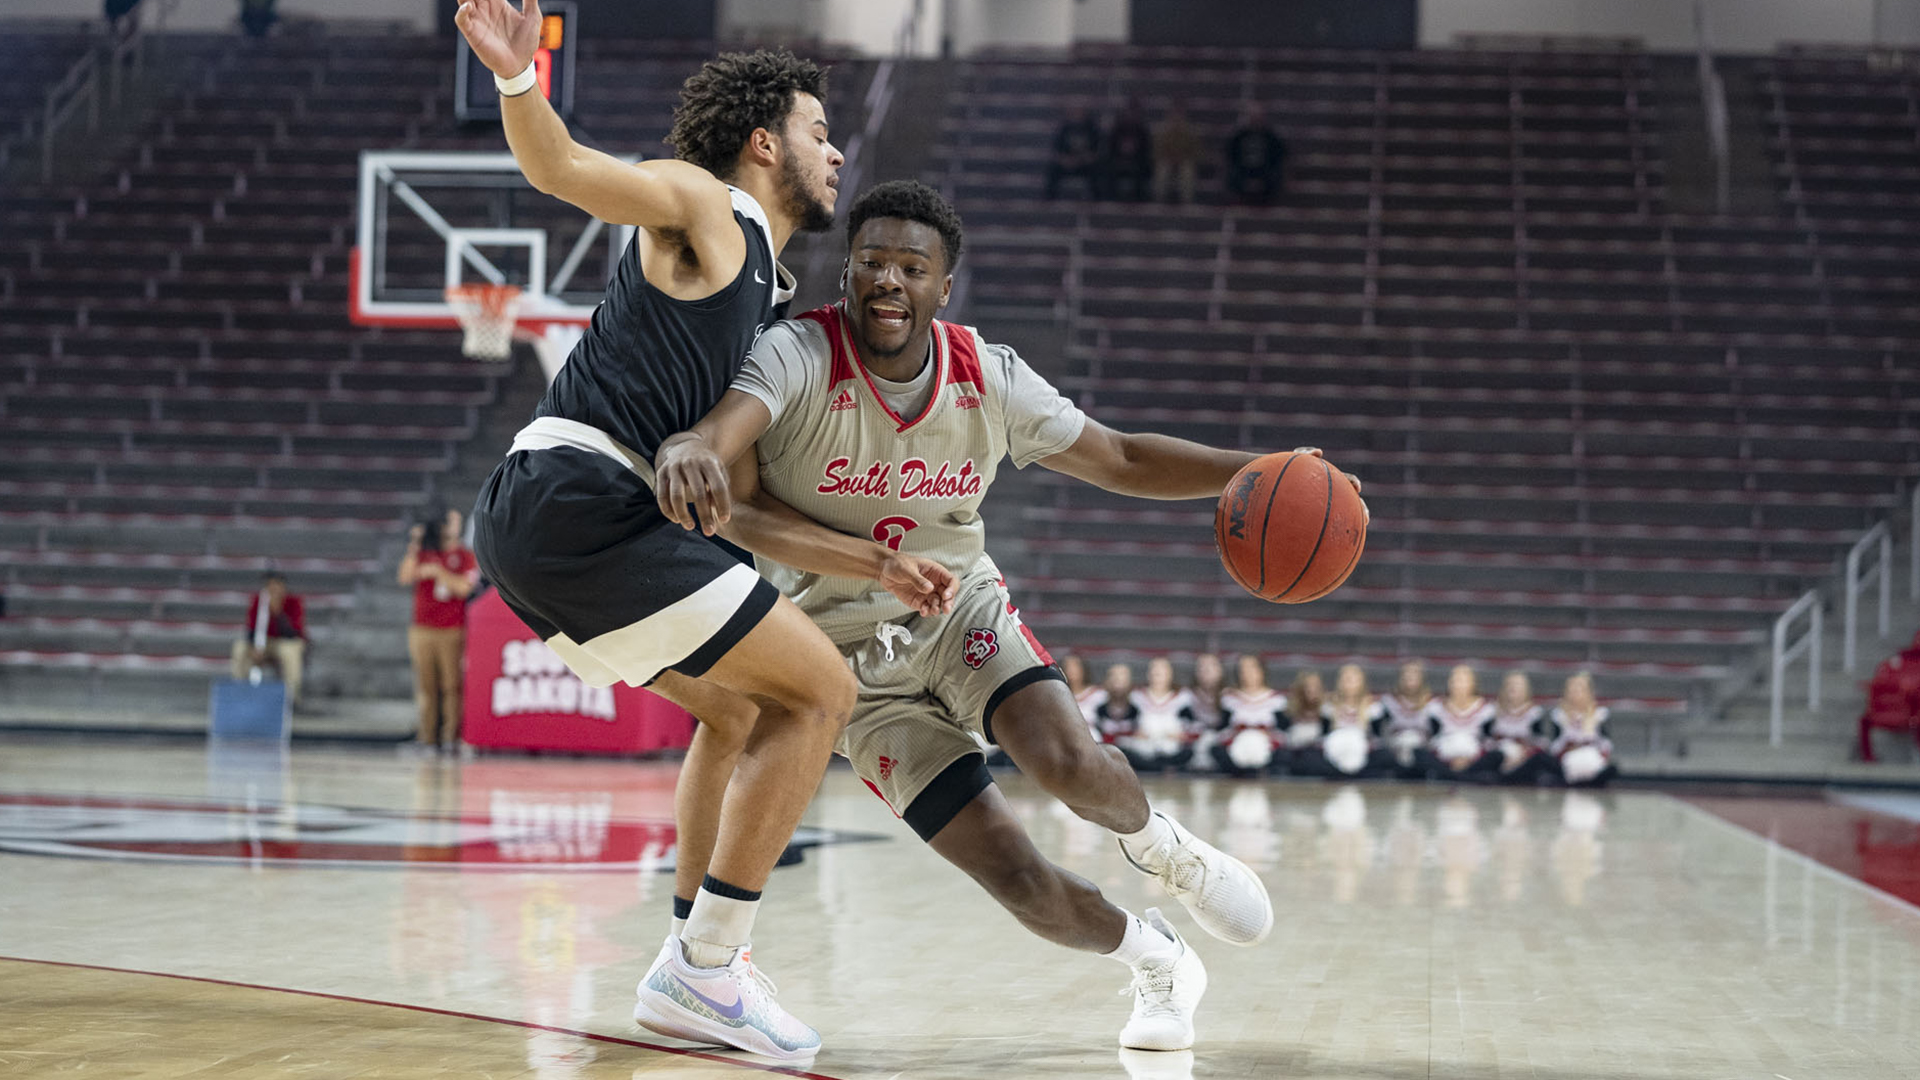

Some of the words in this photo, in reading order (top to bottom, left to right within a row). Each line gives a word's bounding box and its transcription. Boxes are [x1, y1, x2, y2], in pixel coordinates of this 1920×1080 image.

[817, 456, 893, 500] South
[898, 456, 984, 501] Dakota
[1229, 471, 1263, 540] NCAA
[502, 638, 577, 677] SOU
[491, 676, 617, 722] DAKOTA
